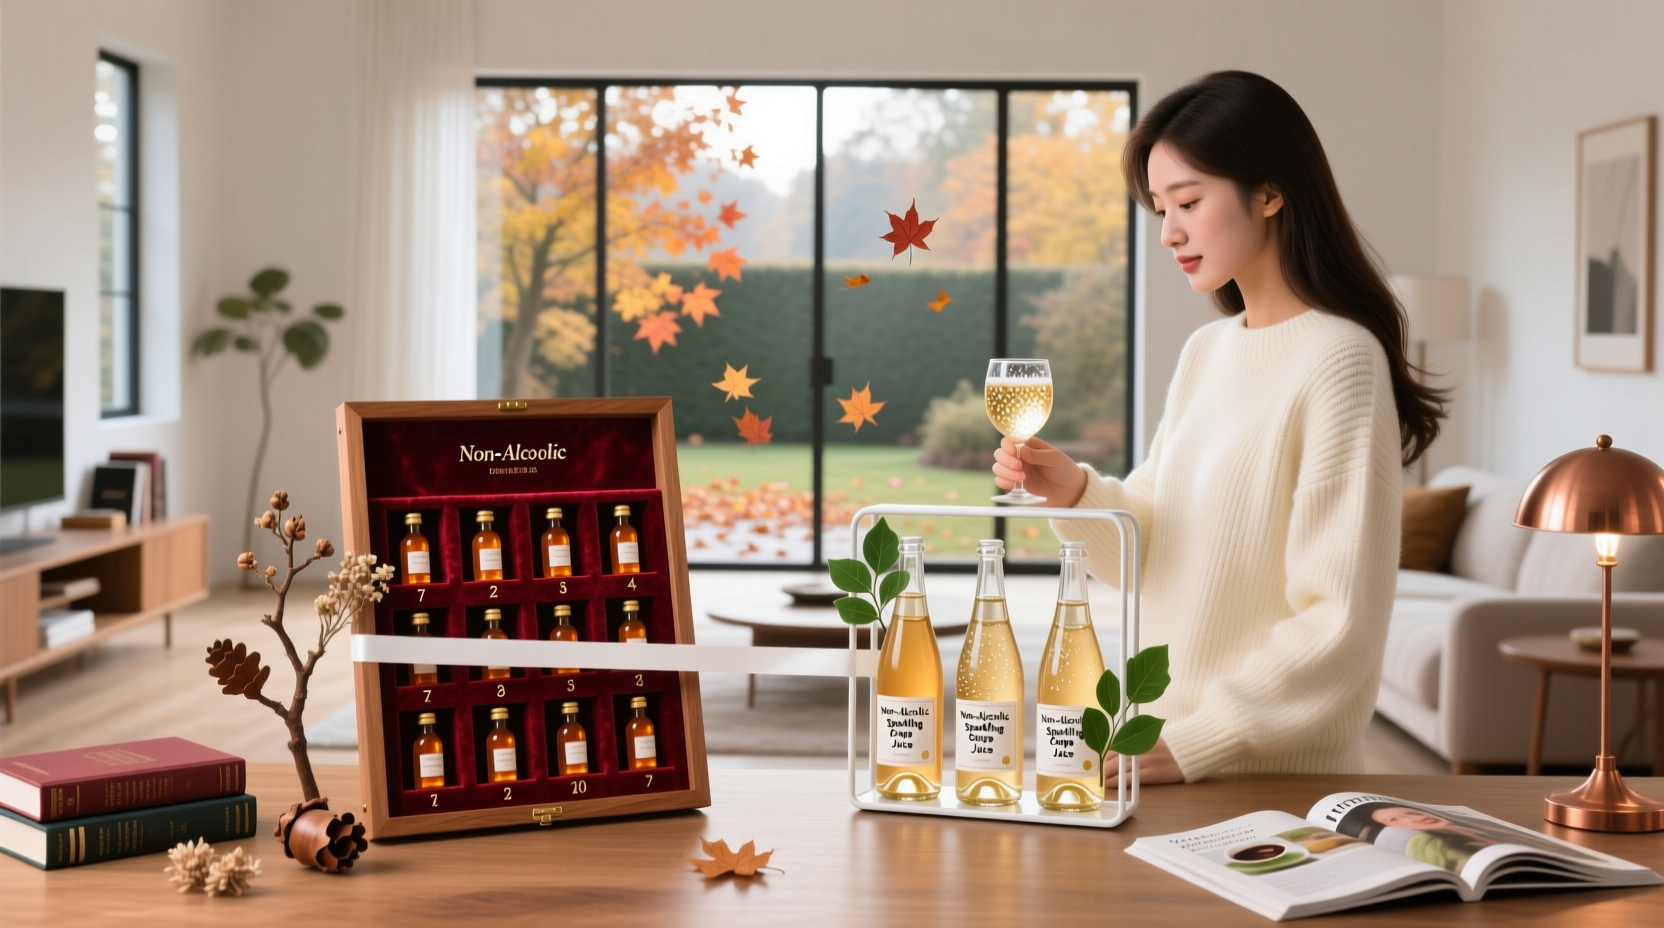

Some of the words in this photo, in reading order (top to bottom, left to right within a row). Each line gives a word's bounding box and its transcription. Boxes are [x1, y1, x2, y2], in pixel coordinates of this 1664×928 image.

[627, 577, 637, 591] 4
[417, 588, 426, 602] 7
[489, 585, 499, 599] 2
[645, 774, 654, 787] 7
[503, 787, 513, 800] 2
